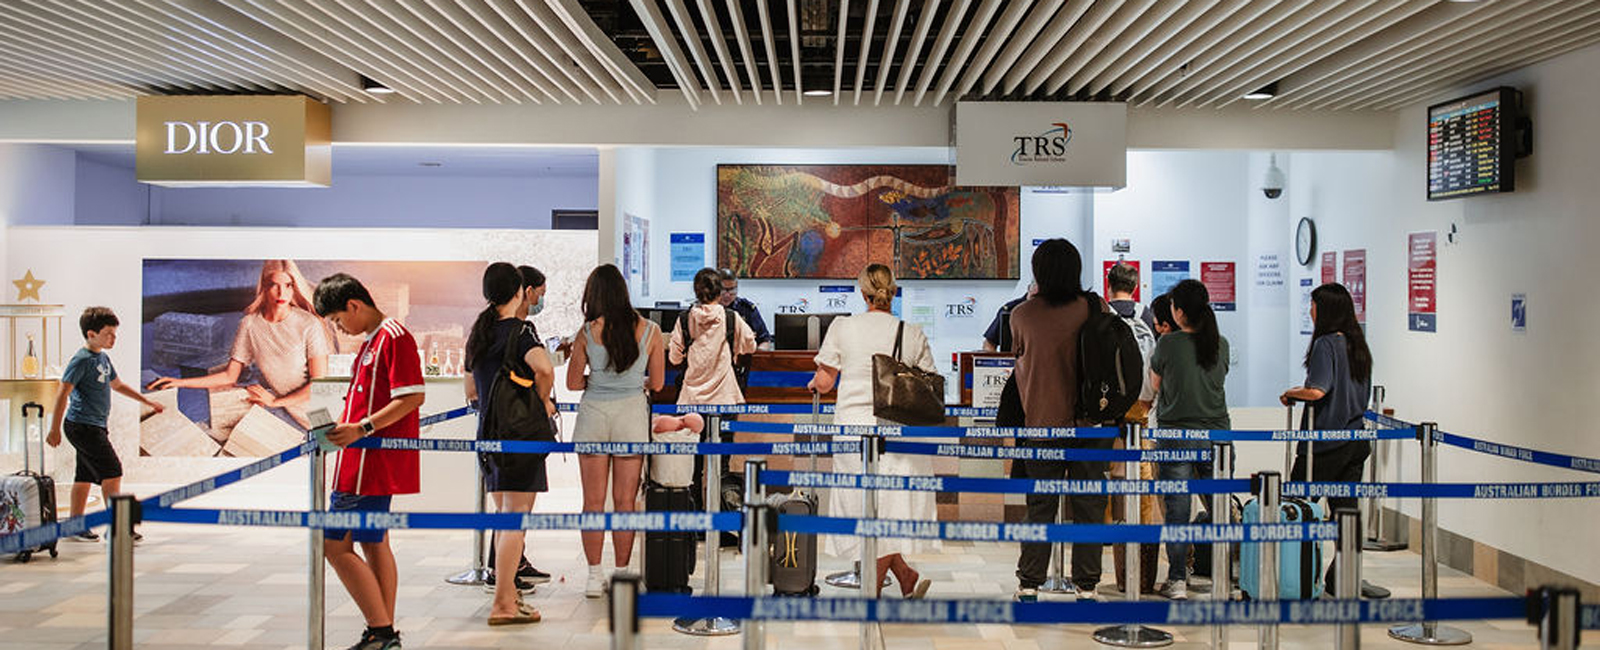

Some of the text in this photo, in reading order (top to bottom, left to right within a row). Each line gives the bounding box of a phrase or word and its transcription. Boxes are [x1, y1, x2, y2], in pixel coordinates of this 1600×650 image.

[164, 121, 273, 154] DIOR
[1014, 137, 1066, 156] TRS
[778, 305, 807, 313] TRS
[946, 304, 974, 315] TRS
[677, 404, 717, 413] AUSTRALIAN
[748, 404, 769, 413] FORCE
[981, 408, 998, 416] FORC
[793, 424, 901, 436] AUSTRALIAN BORDER FORCE
[966, 427, 1076, 437] AUSTRALIAN BORDER FORCE
[1152, 429, 1183, 439] BORDER
[1185, 429, 1210, 439] FORCE
[1272, 430, 1378, 440] AUSTRALIAN BORDER FORCE
[381, 438, 434, 449] AUSTRALIAN
[474, 441, 503, 452] FORCE
[574, 443, 629, 453] AUSTRALIAN
[772, 442, 861, 454] AUSTRALIAN BORDE
[937, 445, 1066, 460] AUSTRALIAN BORDER FORCE
[1140, 450, 1198, 461] AUSTRALIAN
[788, 472, 944, 490] AUSTRALIAN BORDER FORCE
[1034, 480, 1188, 493] AUSTRALIAN BORDER FORCE
[1309, 483, 1350, 496] BORDER
[1355, 484, 1388, 497] FORCE
[1474, 485, 1537, 498] AUSTRALIAN
[1542, 484, 1581, 497] BORDER
[218, 510, 409, 529] AUSTRALIAN BORDER FORCE
[521, 513, 714, 530] AUSTRALIAN BORDER FORCE
[855, 520, 1048, 541] AUSTRALIAN BORDER FORCE
[1160, 525, 1243, 542] AUSTRALIAN
[1250, 524, 1302, 541] BORDER
[1167, 600, 1424, 623] AUSTRALIAN BORDER FORCE
